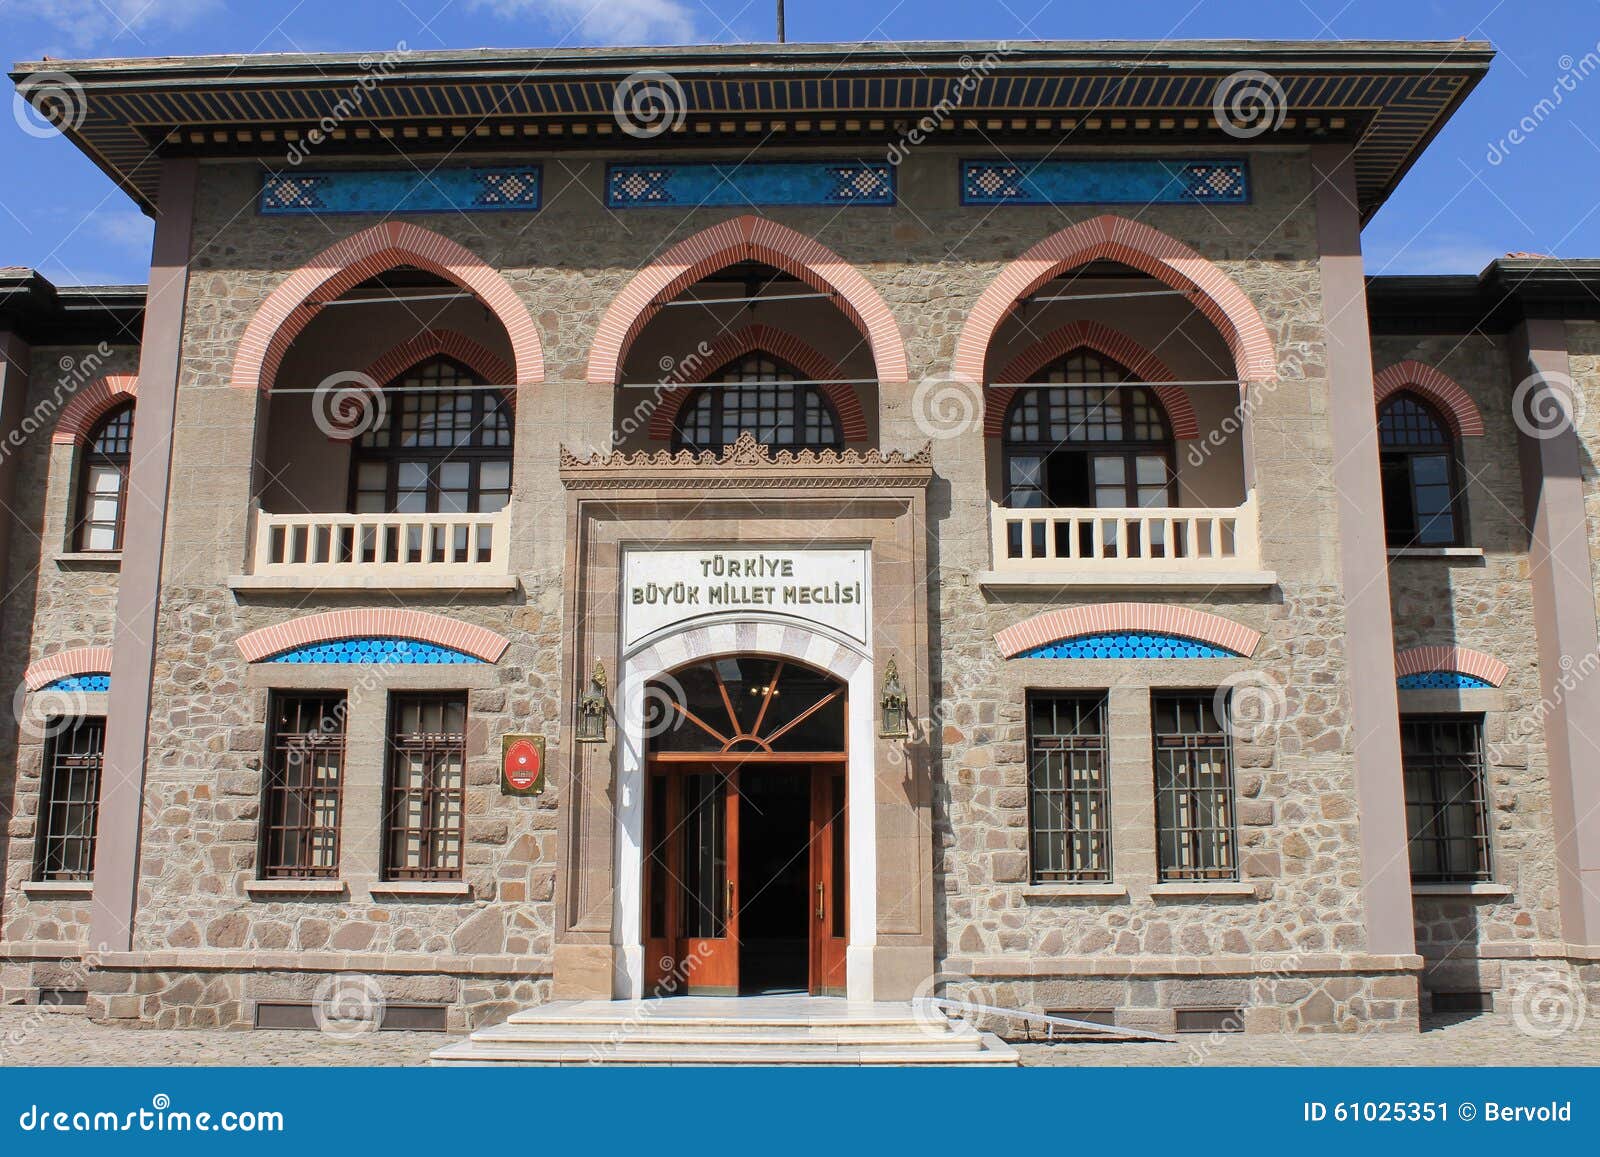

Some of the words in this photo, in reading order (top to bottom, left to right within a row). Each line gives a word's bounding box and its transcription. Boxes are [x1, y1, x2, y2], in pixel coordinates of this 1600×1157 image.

[700, 554, 794, 577] TÜRKİYE
[632, 583, 699, 605] BÜYÜK
[708, 581, 775, 605] MİLLET
[783, 580, 861, 605] MECLİSİ
